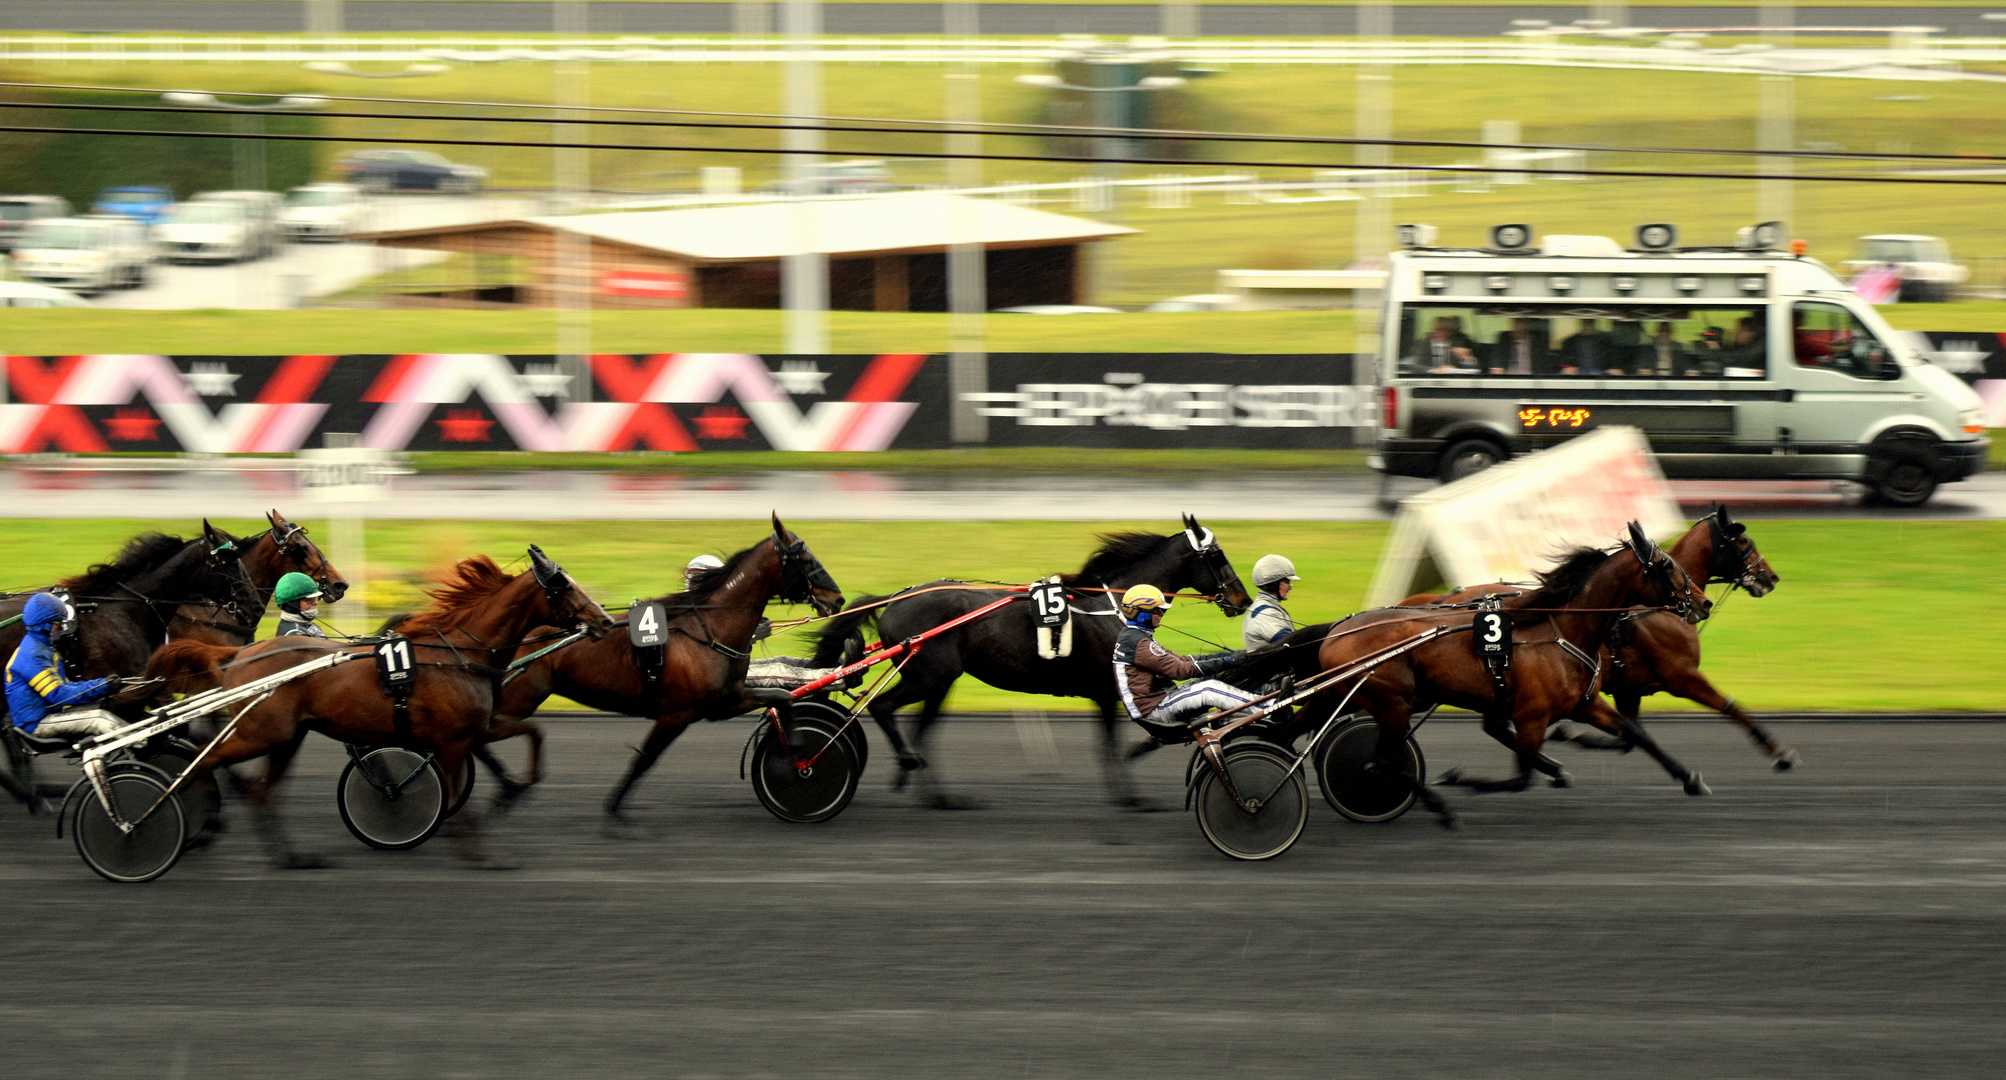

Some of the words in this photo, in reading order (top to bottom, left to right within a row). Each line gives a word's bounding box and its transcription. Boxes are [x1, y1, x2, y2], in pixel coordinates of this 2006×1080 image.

[1032, 586, 1066, 616] 15
[638, 606, 659, 635] 4
[1483, 613, 1502, 643] 3
[378, 640, 411, 672] 11
